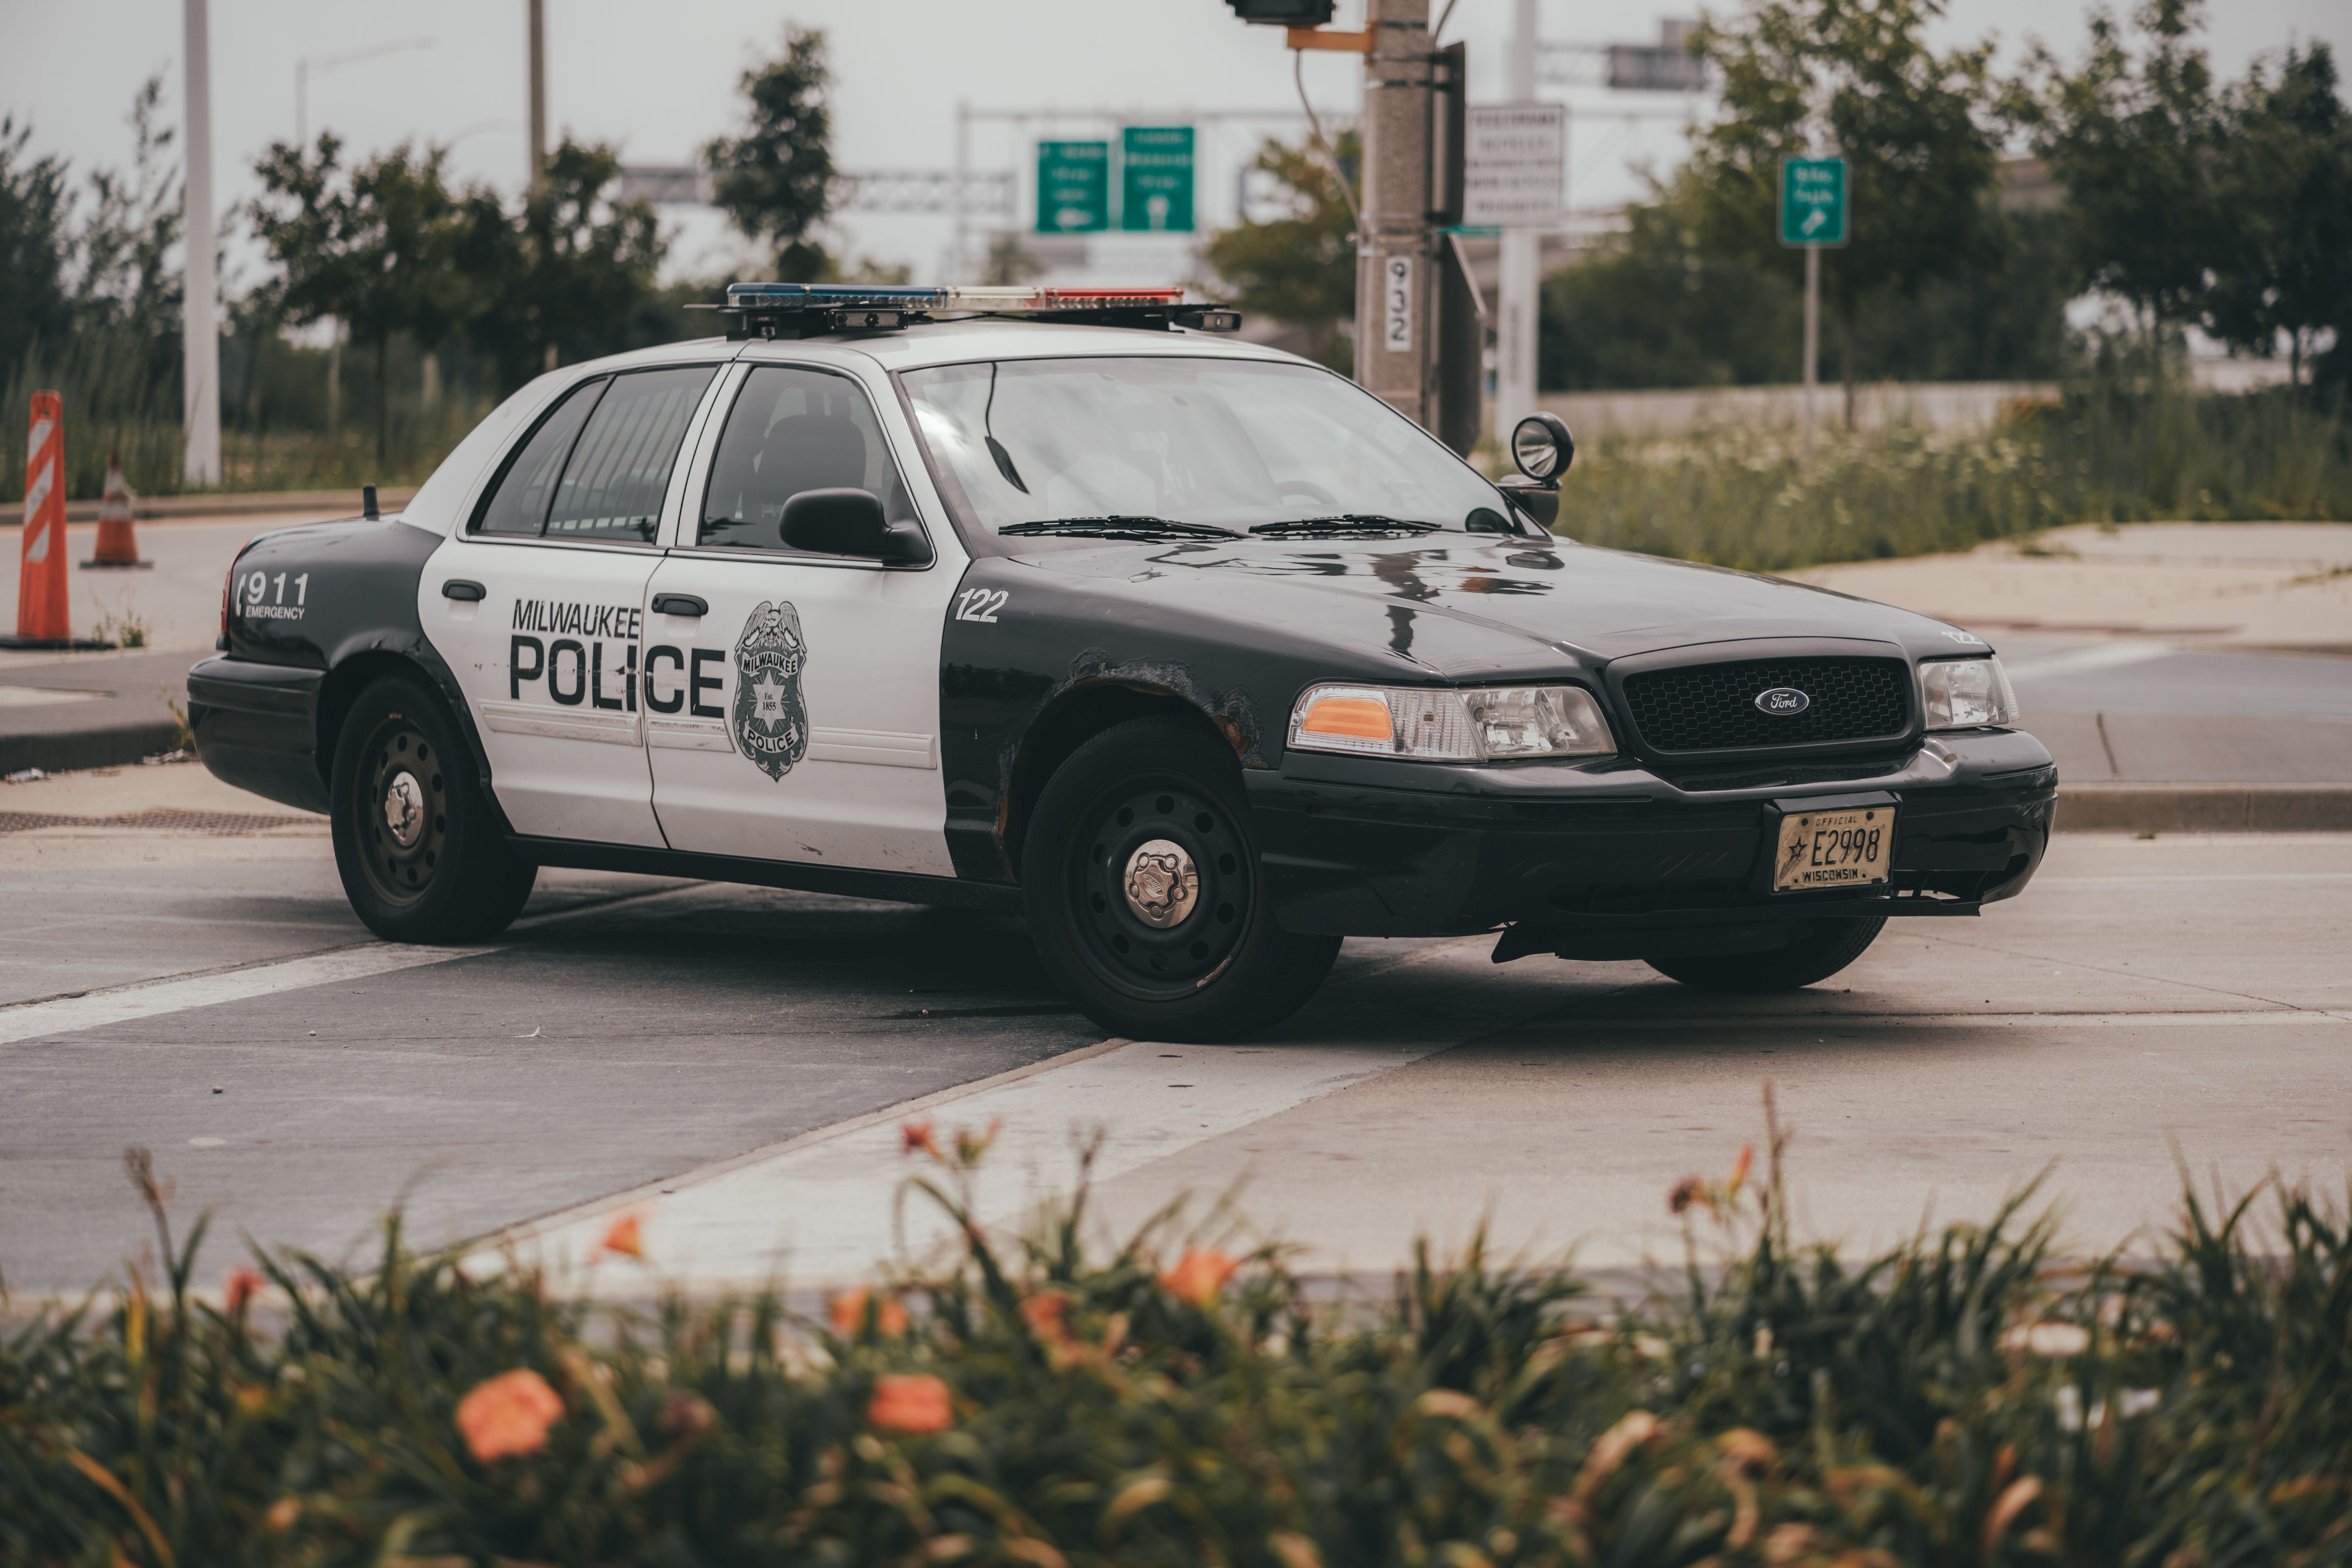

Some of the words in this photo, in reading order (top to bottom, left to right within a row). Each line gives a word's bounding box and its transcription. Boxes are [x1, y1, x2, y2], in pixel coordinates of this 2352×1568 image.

[1391, 262, 1406, 341] 932
[248, 571, 308, 605] 911
[245, 605, 305, 620] EMERGENCY
[956, 588, 1009, 623] 122
[512, 599, 641, 639] MILWAUKEE
[743, 653, 796, 673] MILWAUKEE
[510, 634, 726, 719] POLICE
[763, 702, 776, 710] 1855
[1770, 693, 1797, 709] Ford
[747, 729, 794, 752] POLICE
[1816, 816, 1858, 826] OFFICIAL
[1811, 828, 1880, 866] E2998
[1803, 868, 1858, 882] WISCONSIN
